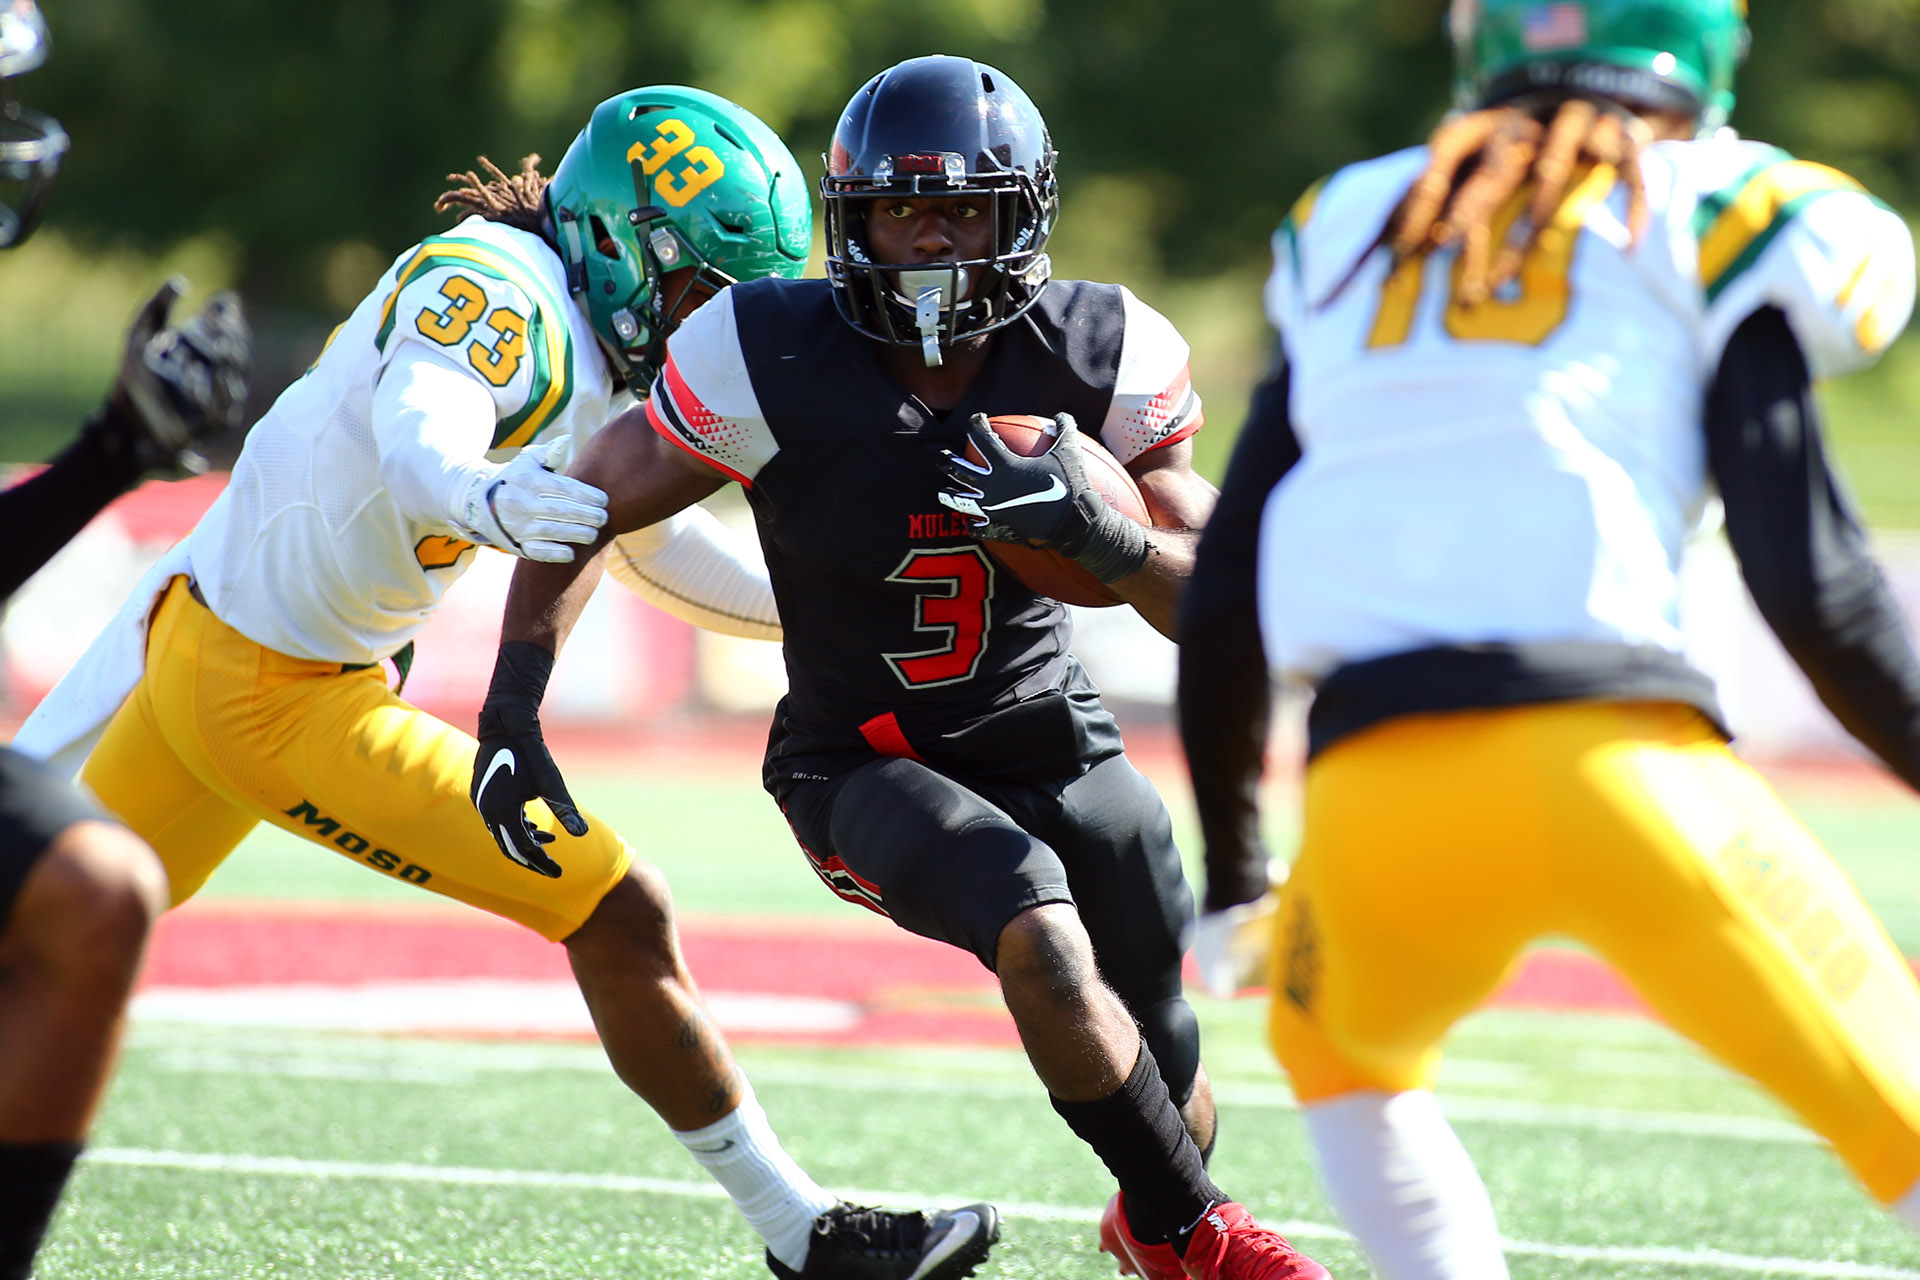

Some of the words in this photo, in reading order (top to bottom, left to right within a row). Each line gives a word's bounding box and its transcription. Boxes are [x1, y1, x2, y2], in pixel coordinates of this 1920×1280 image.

[627, 119, 725, 207] 33
[415, 275, 529, 387] 33
[881, 545, 995, 689] 3
[281, 798, 432, 884] MOSO
